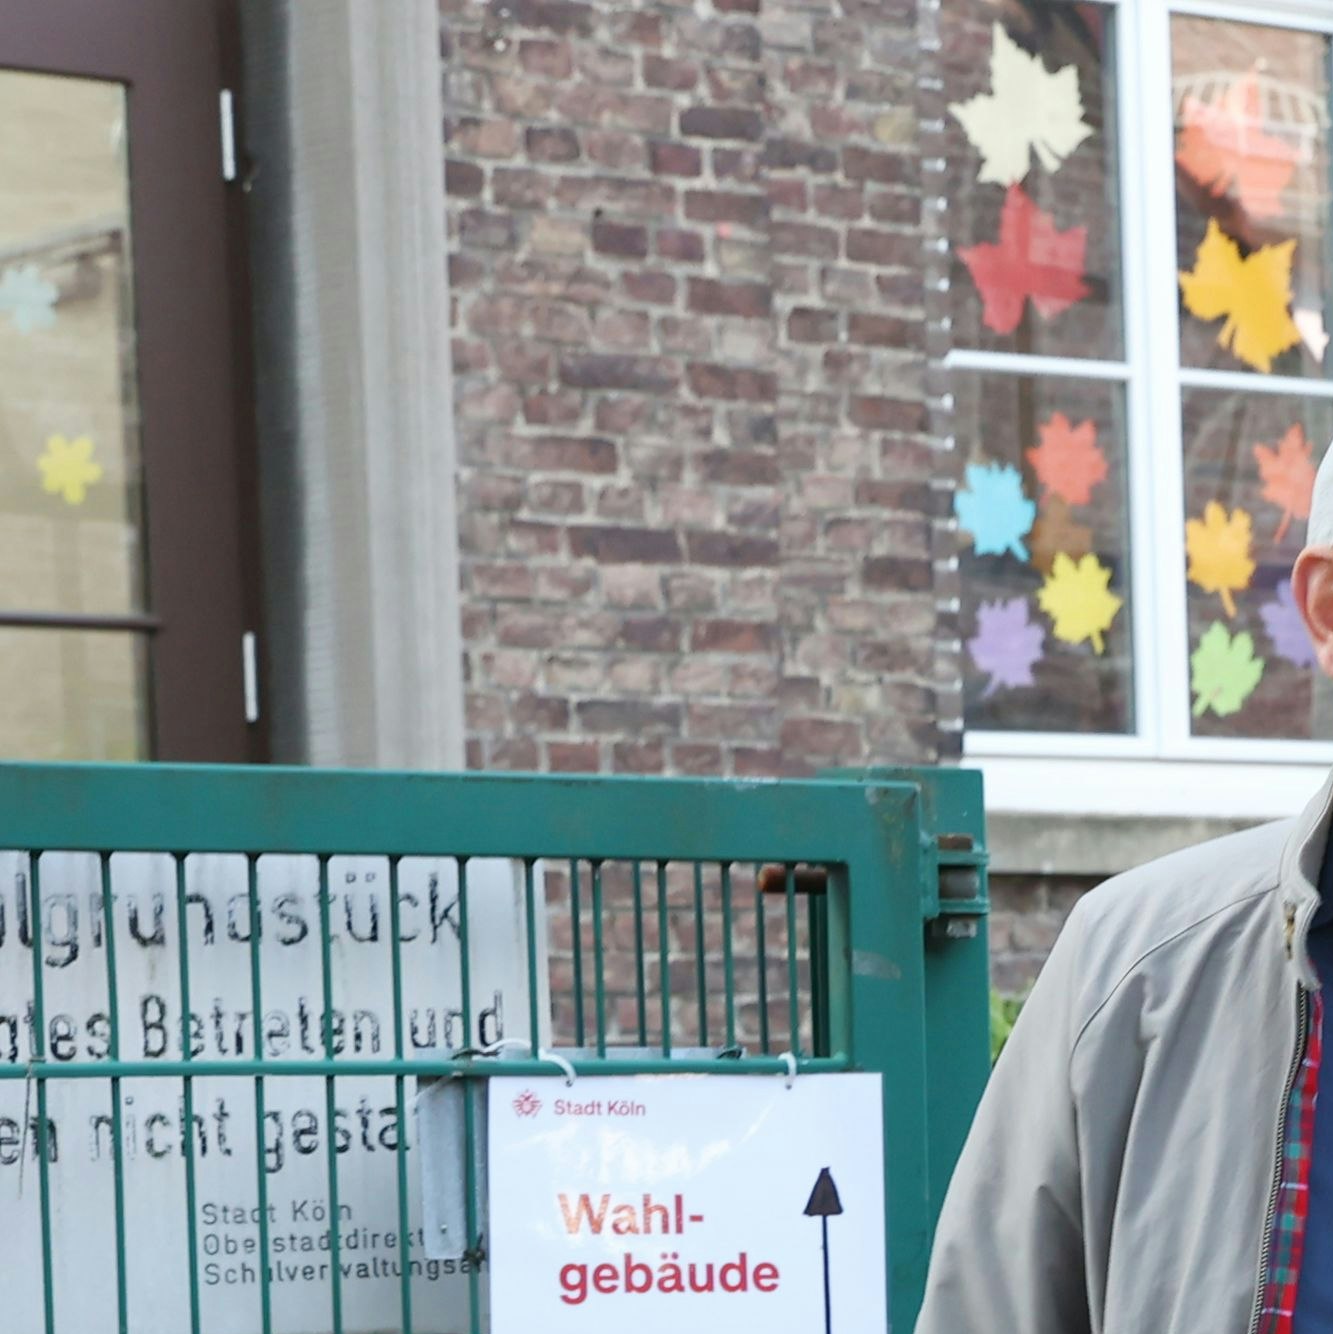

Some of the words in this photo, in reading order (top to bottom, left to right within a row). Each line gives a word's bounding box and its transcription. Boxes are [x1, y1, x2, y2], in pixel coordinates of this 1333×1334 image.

[0, 872, 463, 968] lgrundsück
[140, 993, 380, 1058] Betreten
[409, 989, 504, 1050] und
[555, 1099, 602, 1116] Stadt
[607, 1099, 646, 1116] Köln
[89, 1095, 233, 1163] nicht
[260, 1094, 419, 1174] gesta
[291, 1199, 353, 1222] Kön
[557, 1193, 704, 1235] Wahl-
[203, 1227, 426, 1256] Obestaddiret
[559, 1252, 780, 1305] gebäude
